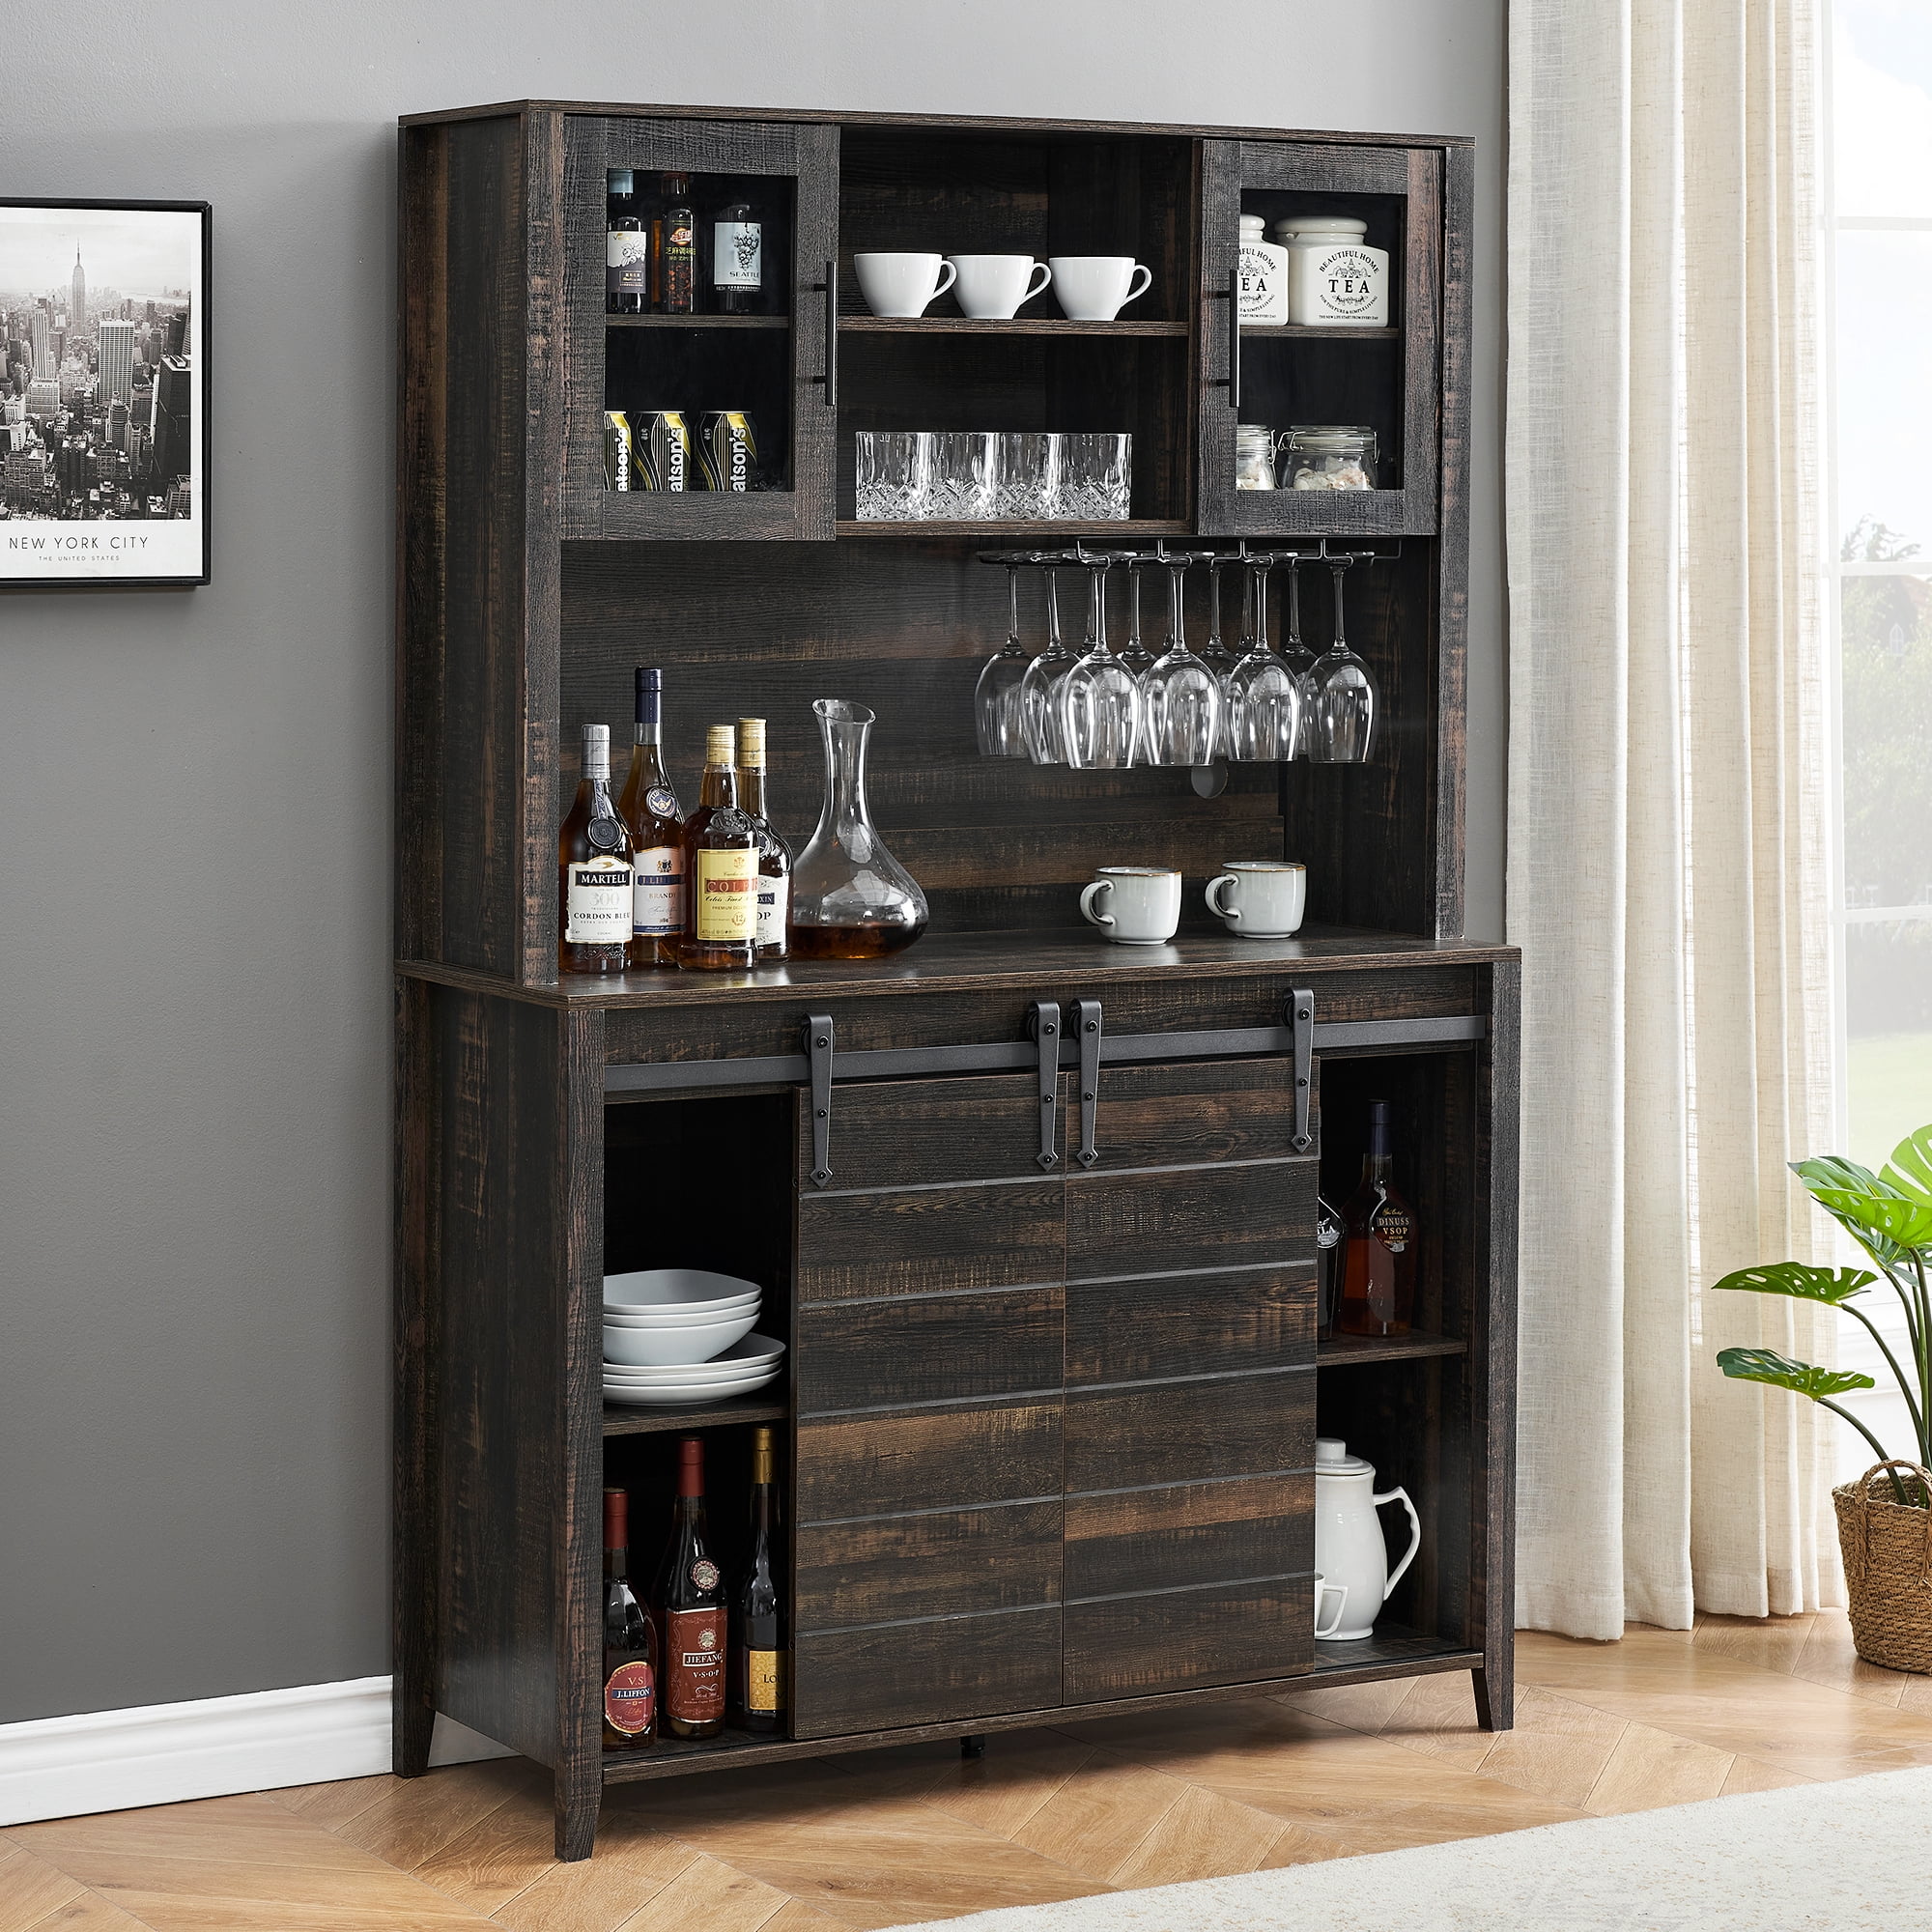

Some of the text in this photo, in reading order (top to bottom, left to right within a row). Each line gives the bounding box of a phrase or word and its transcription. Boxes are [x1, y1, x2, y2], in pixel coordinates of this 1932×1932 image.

[1257, 250, 1276, 271] HOME
[1319, 250, 1380, 274] BEAUTIFUL HOME
[1241, 277, 1267, 292] EA
[1328, 279, 1370, 294] TEA
[614, 427, 629, 492] atson's
[668, 427, 684, 492] atson's
[730, 427, 747, 492] atson's
[9, 536, 149, 550] NEW YORK CITY
[581, 873, 627, 884] MARTELL
[589, 892, 620, 907] 300
[735, 914, 743, 923] 12
[1378, 1217, 1410, 1226] DINUSS
[1382, 1227, 1408, 1236] VSOP
[686, 1653, 723, 1664] JIEFANG
[628, 1676, 644, 1686] V.S
[616, 1688, 650, 1698] J.LIFFON
